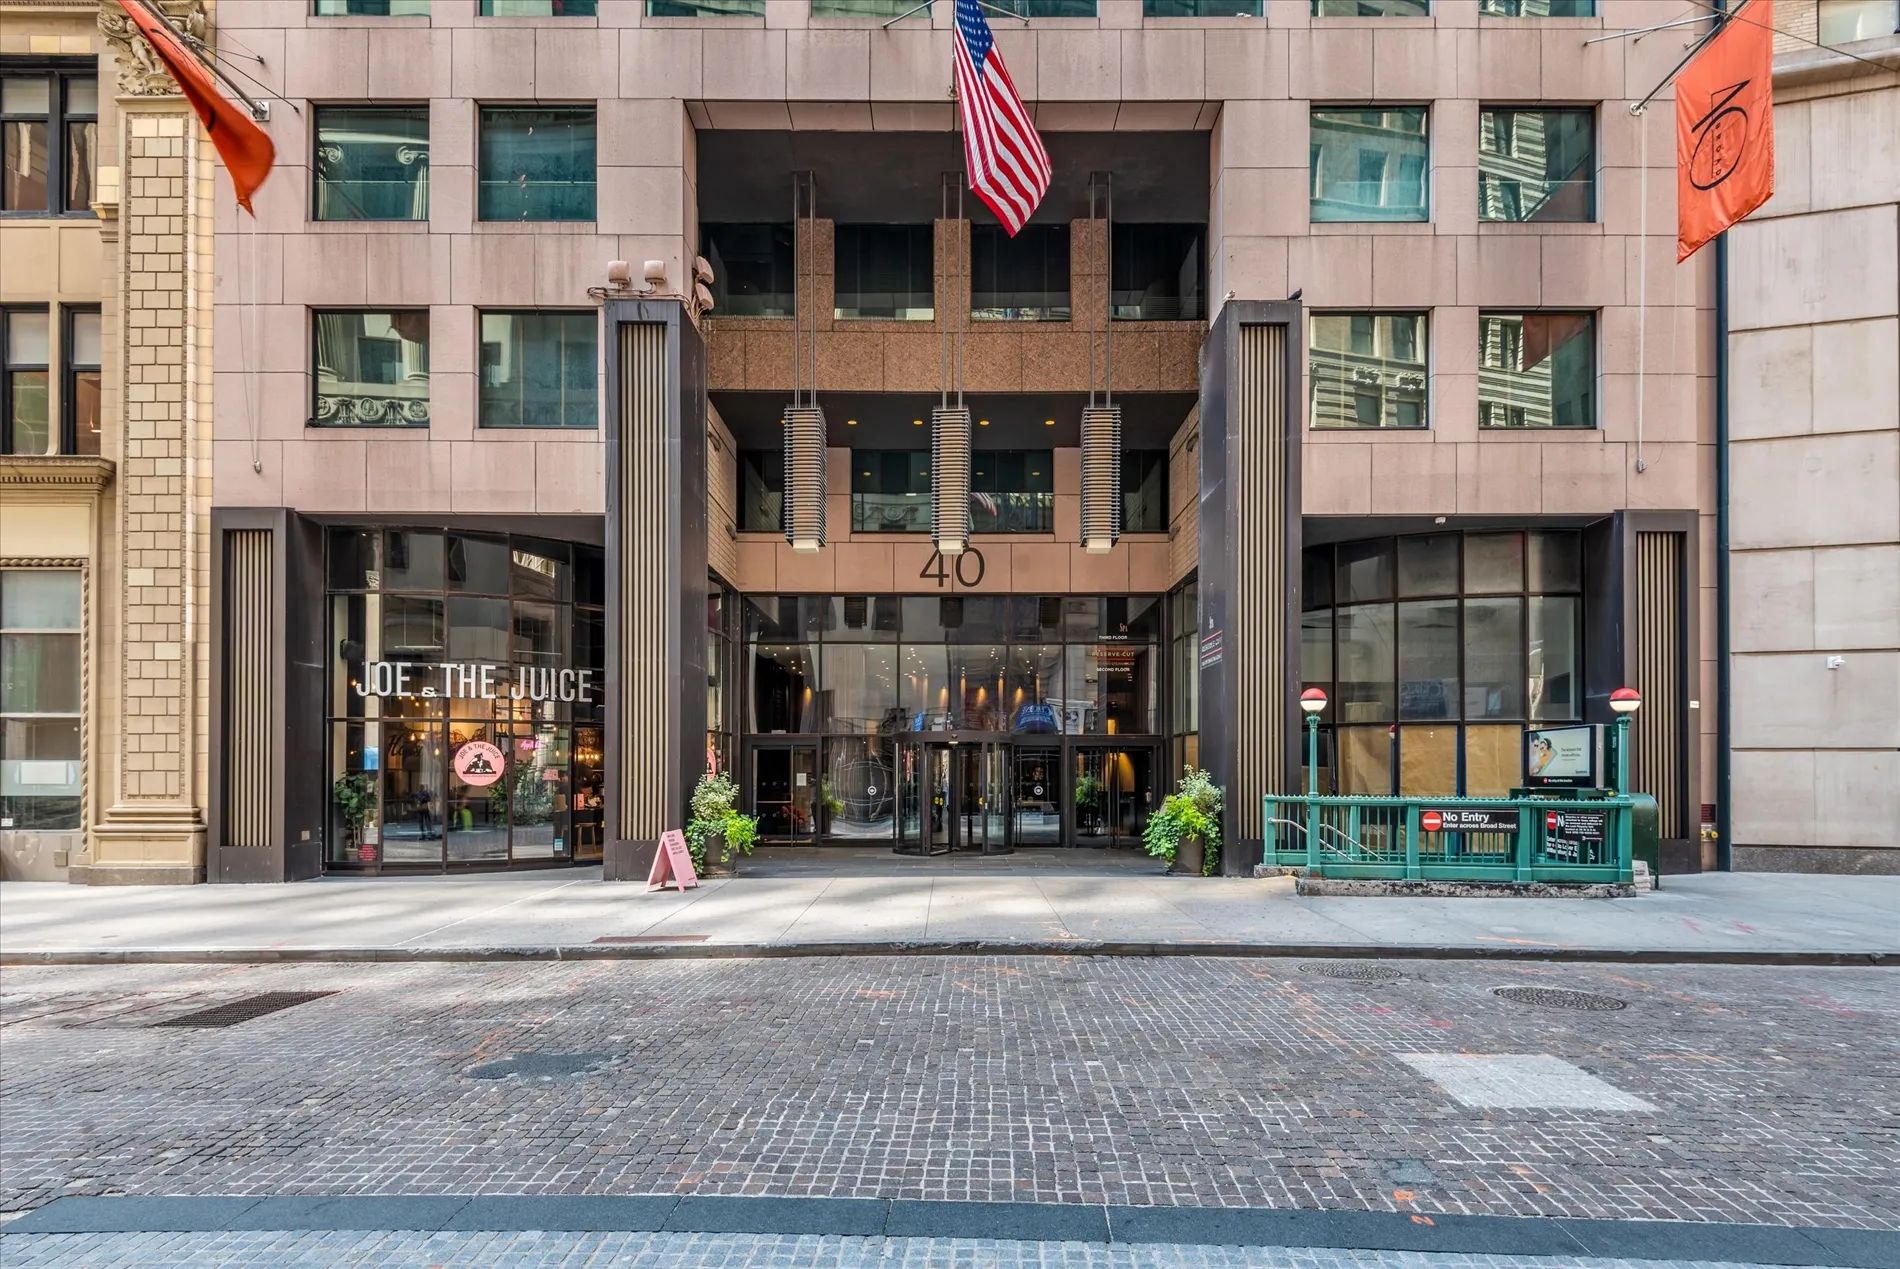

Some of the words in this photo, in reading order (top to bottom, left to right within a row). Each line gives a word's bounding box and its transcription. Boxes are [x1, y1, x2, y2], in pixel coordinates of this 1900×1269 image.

[919, 547, 986, 588] 40
[356, 661, 412, 697] JOE
[421, 686, 437, 698] &
[440, 663, 497, 699] THE
[511, 667, 593, 703] JUICE
[458, 748, 469, 760] JOE
[485, 746, 502, 760] JUICE
[1442, 812, 1458, 822] No
[1461, 812, 1490, 824] Entry
